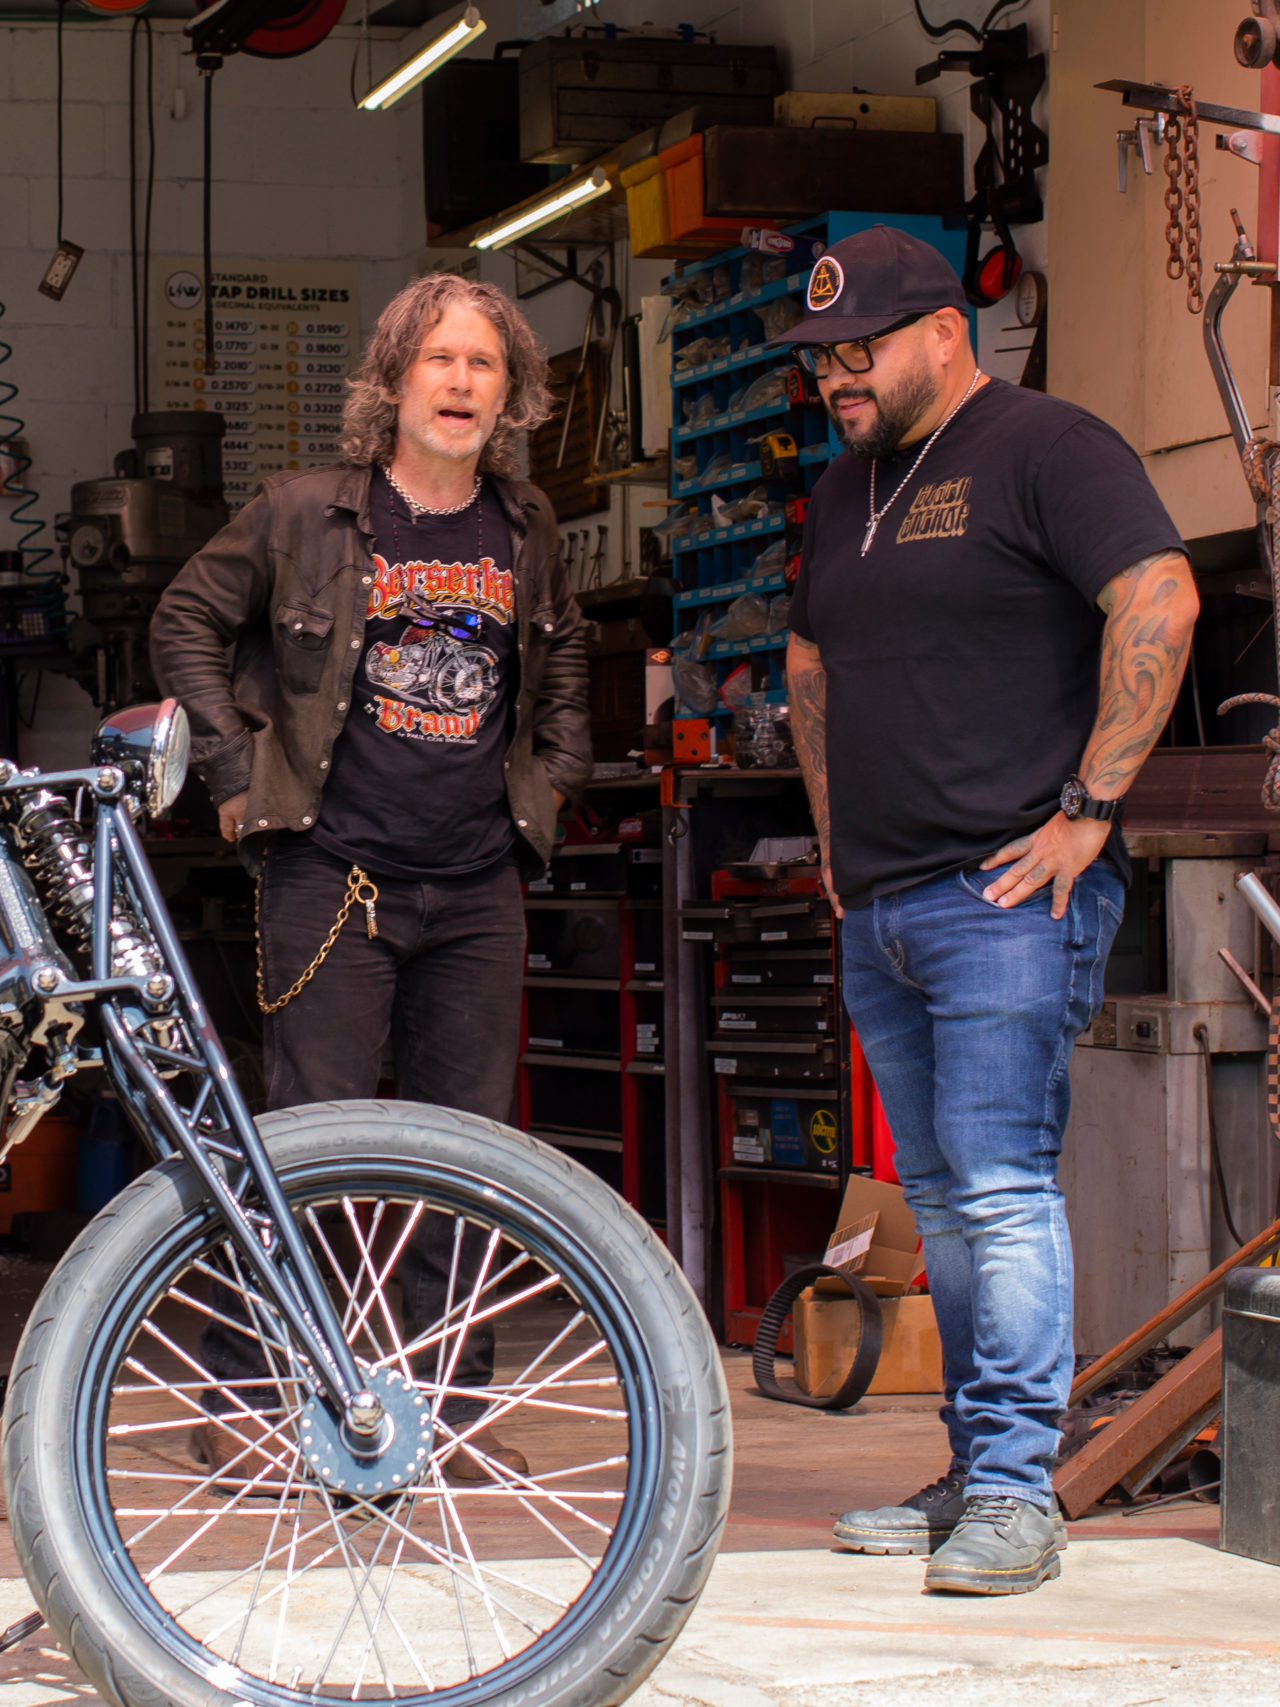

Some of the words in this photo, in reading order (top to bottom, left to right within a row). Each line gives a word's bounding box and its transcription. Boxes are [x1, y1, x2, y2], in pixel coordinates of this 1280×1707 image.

[210, 285, 242, 299] TAP
[246, 286, 297, 301] DRILL
[301, 288, 349, 303] SIZES
[258, 302, 320, 312] EQUIVALENTS
[366, 554, 516, 622] Berserke
[374, 695, 482, 738] Brand
[660, 1434, 687, 1531] AVON
[596, 1537, 663, 1641] COBRA
